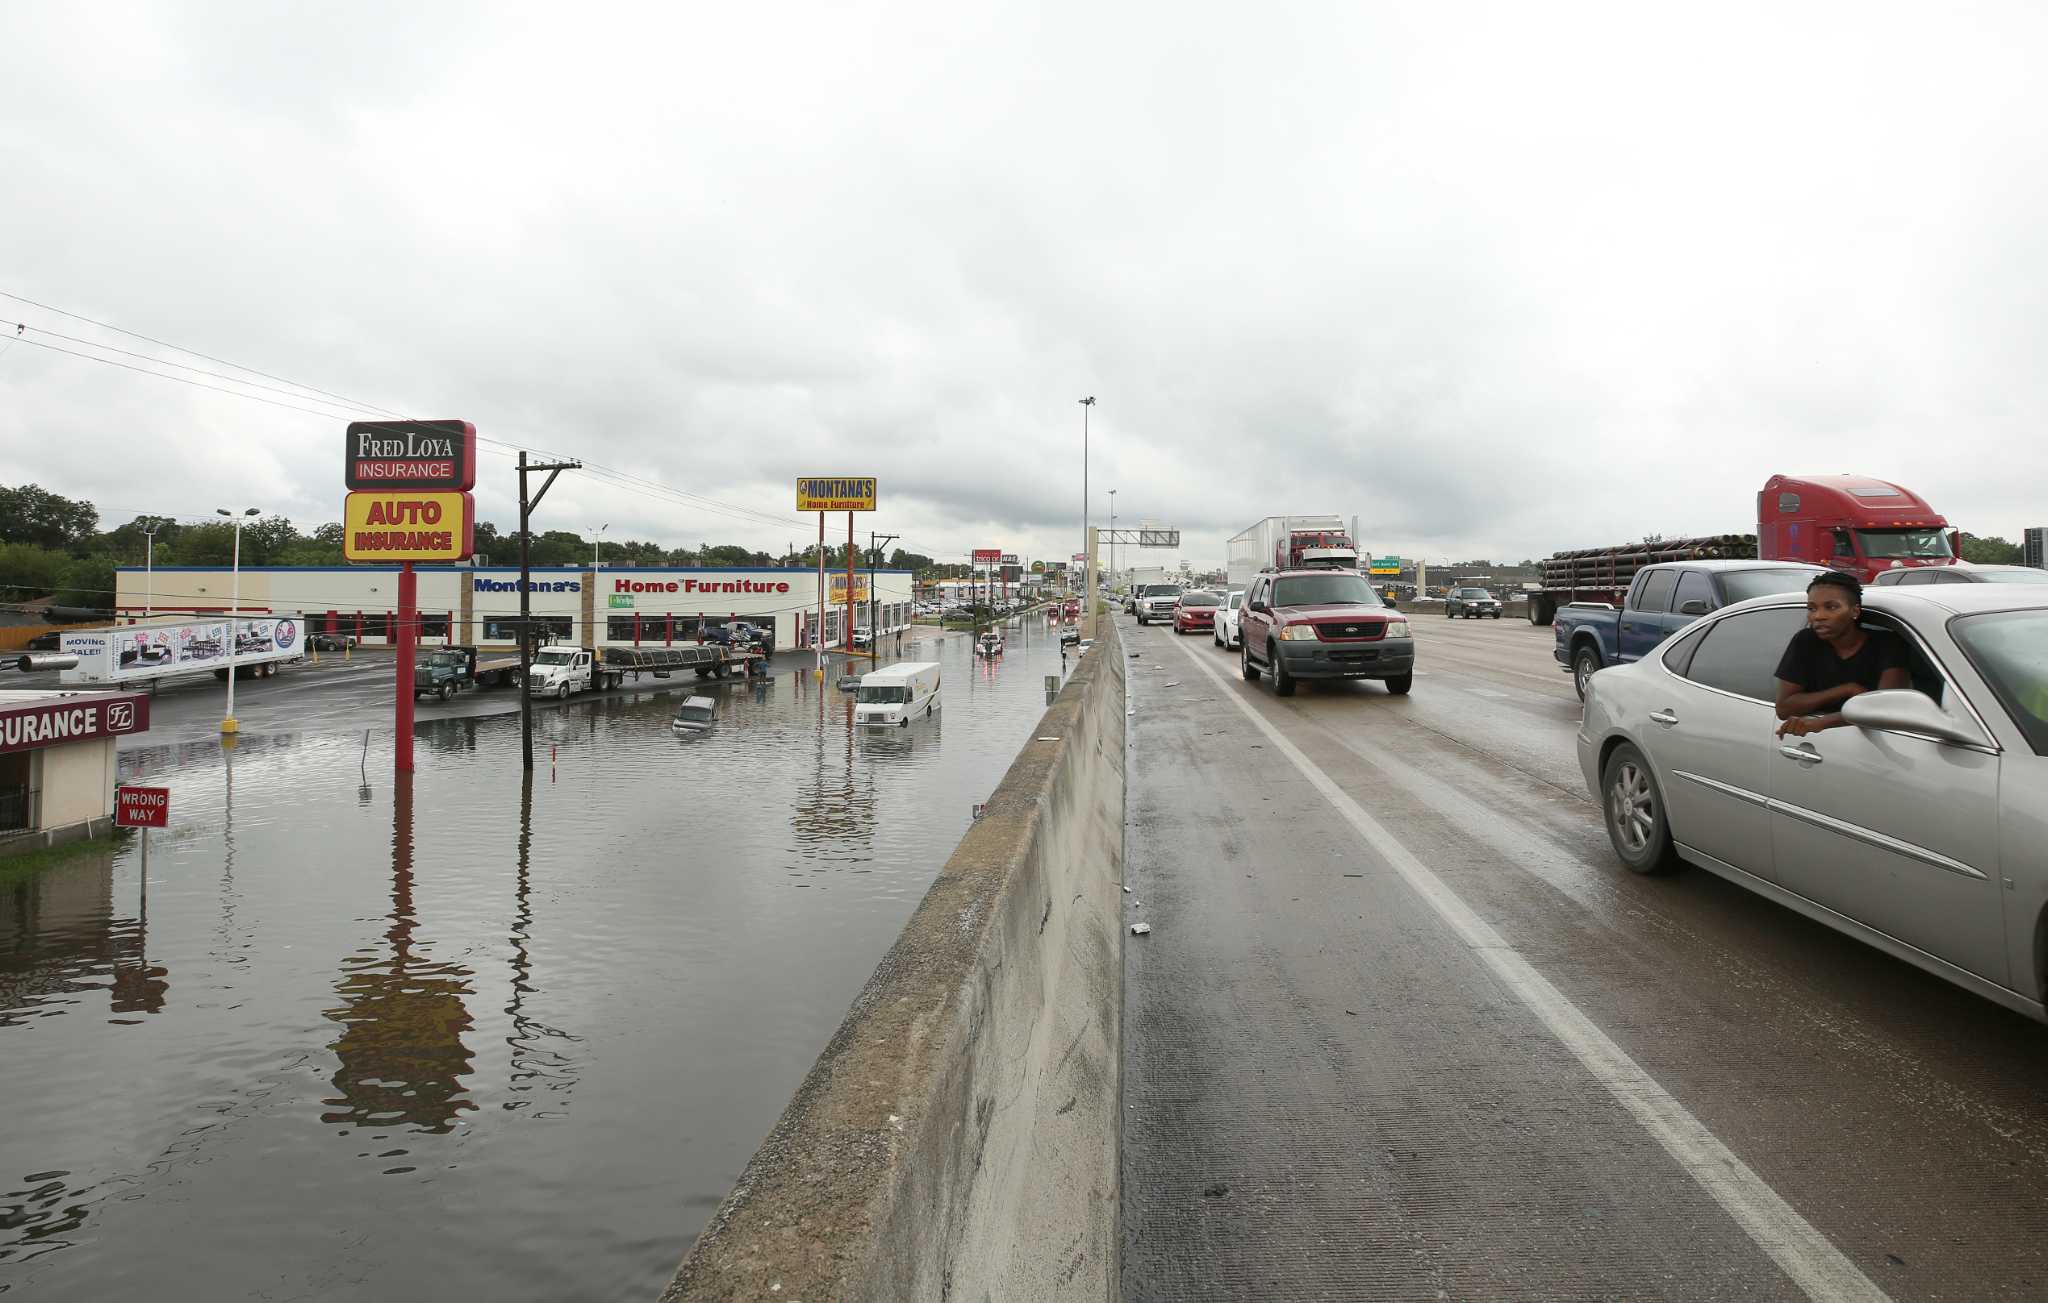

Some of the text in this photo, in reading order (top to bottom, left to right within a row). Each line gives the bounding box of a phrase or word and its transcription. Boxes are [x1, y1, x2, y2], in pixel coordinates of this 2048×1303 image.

[357, 432, 454, 457] FRED LOYA
[359, 463, 451, 477] INSURANCE
[807, 479, 873, 498] MONTANA'S
[806, 500, 865, 509] Home Furniture
[366, 501, 442, 526] AUTO
[354, 530, 453, 551] INSURANCE
[614, 578, 791, 593] Home Furniture
[65, 638, 106, 646] MOVING
[0, 707, 97, 747] URANCE
[121, 791, 166, 807] WRONG
[128, 808, 156, 821] WAY
